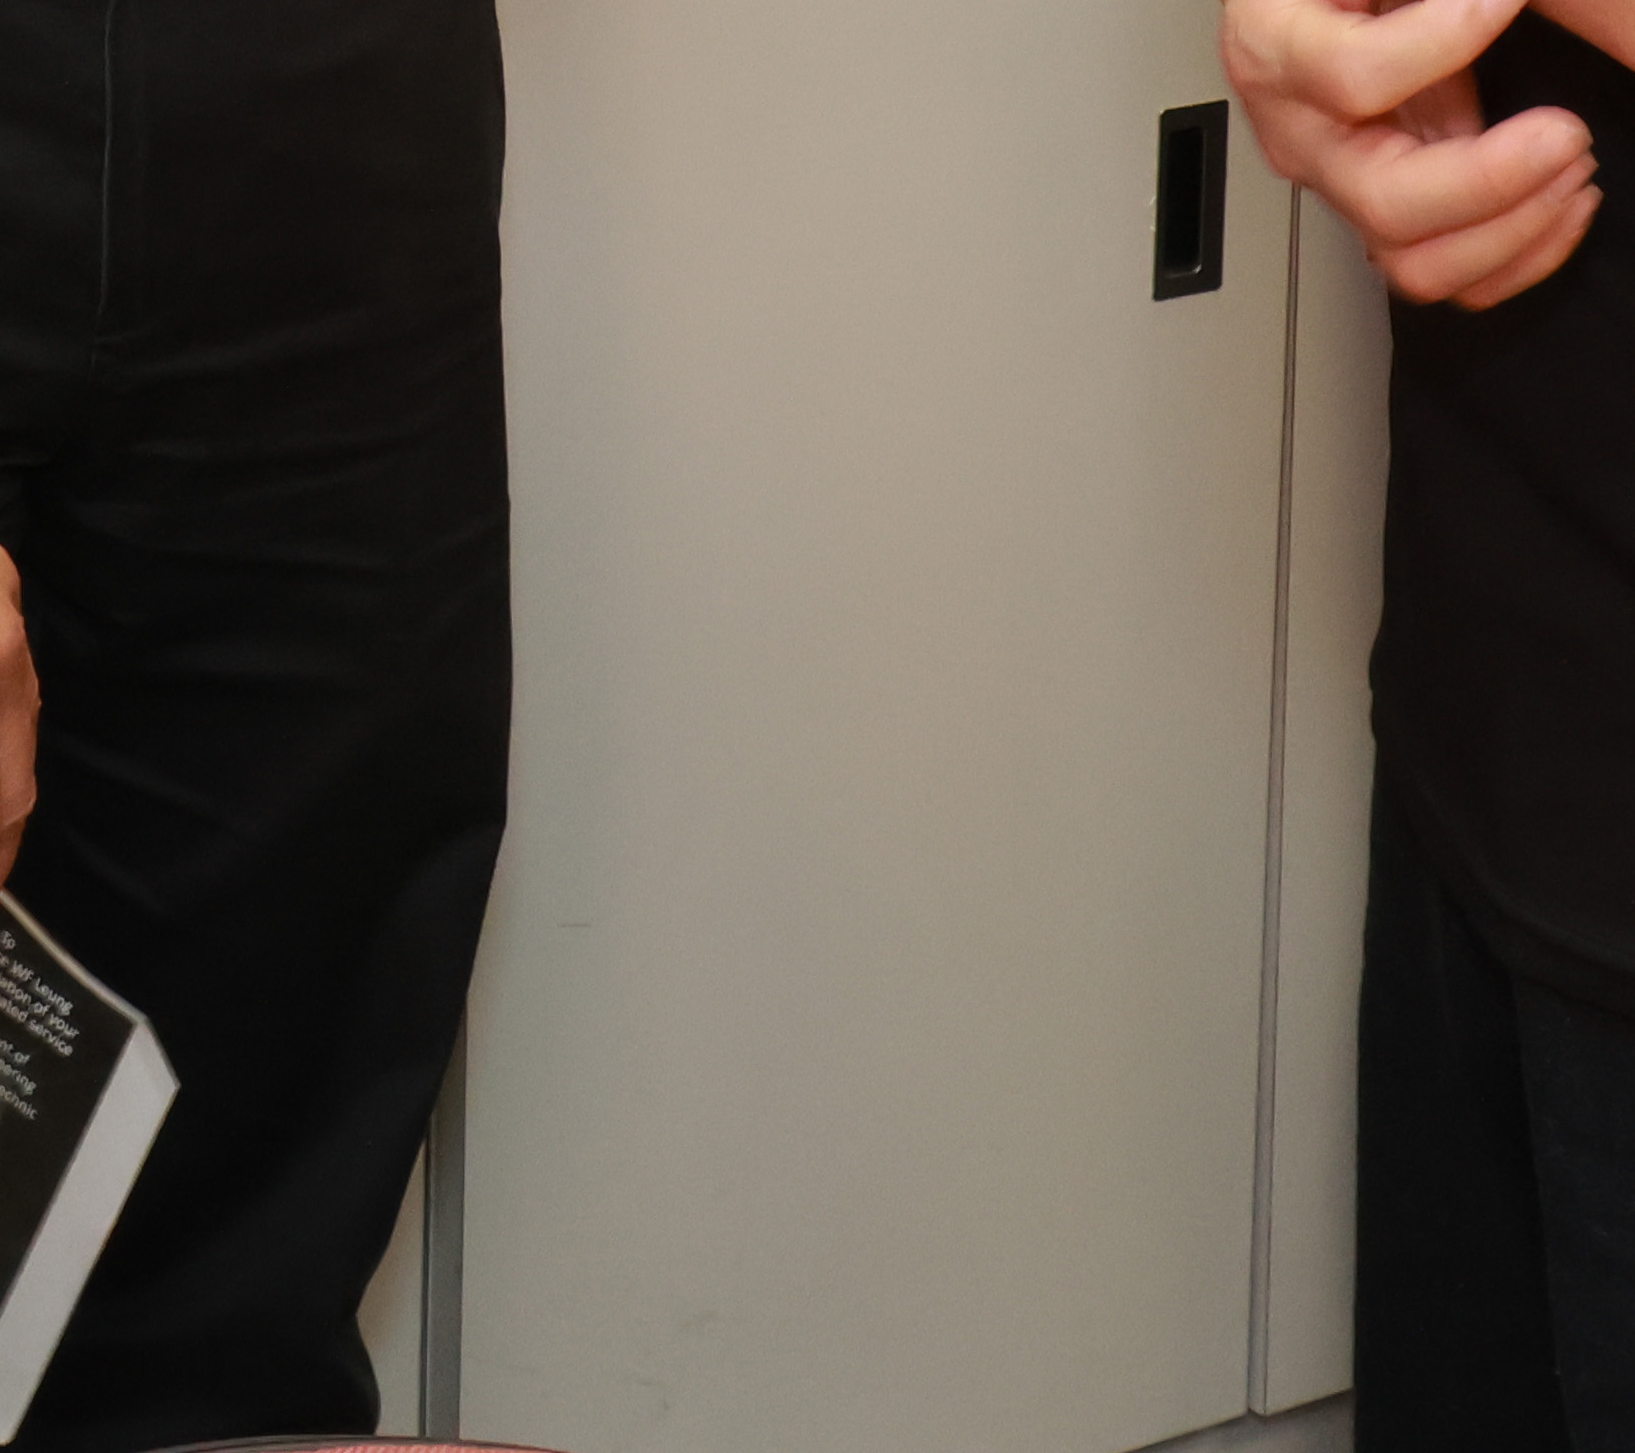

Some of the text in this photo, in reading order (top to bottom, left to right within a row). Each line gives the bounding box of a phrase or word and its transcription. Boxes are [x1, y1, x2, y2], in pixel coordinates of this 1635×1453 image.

[31, 979, 73, 1015] Leung
[28, 1019, 73, 1055] service
[48, 1014, 78, 1040] your
[12, 1049, 29, 1065] of
